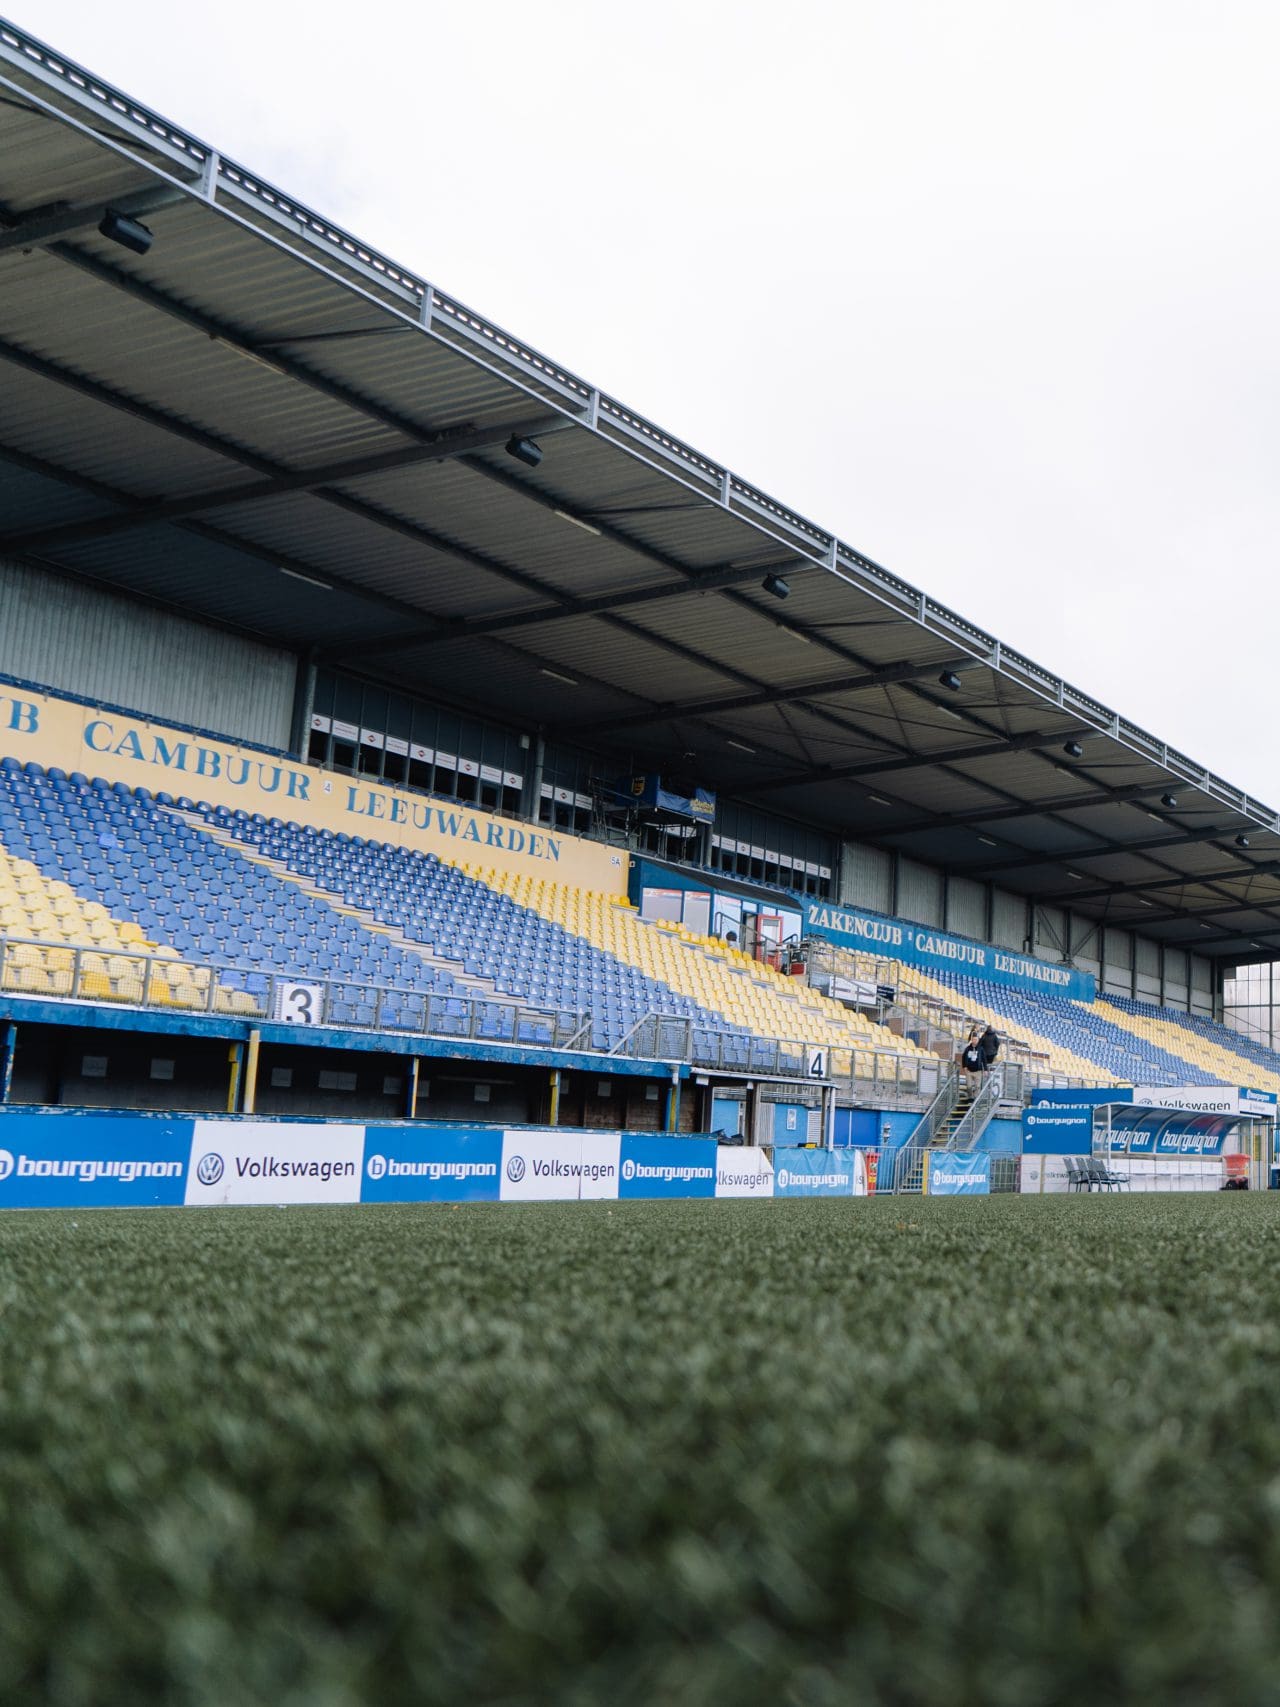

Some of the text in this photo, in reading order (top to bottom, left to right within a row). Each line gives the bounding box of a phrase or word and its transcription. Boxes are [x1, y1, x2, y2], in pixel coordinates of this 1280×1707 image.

[0, 696, 562, 862] B CAMBUUR LEEUWARDEN
[808, 904, 1071, 986] ZAKENCLUB CAMBUUR LEEUWARDEN
[286, 988, 312, 1023] 3
[811, 1052, 823, 1077] 4
[1036, 1116, 1086, 1125] bourguignon
[1161, 1130, 1219, 1152] bourguignon
[17, 1155, 183, 1182] bourguignon
[236, 1156, 355, 1181] Volkswagen
[388, 1158, 497, 1180] bourguignon
[532, 1159, 615, 1181] Volkswagen
[636, 1162, 713, 1181] bourguignon
[717, 1171, 769, 1189] lkswagen
